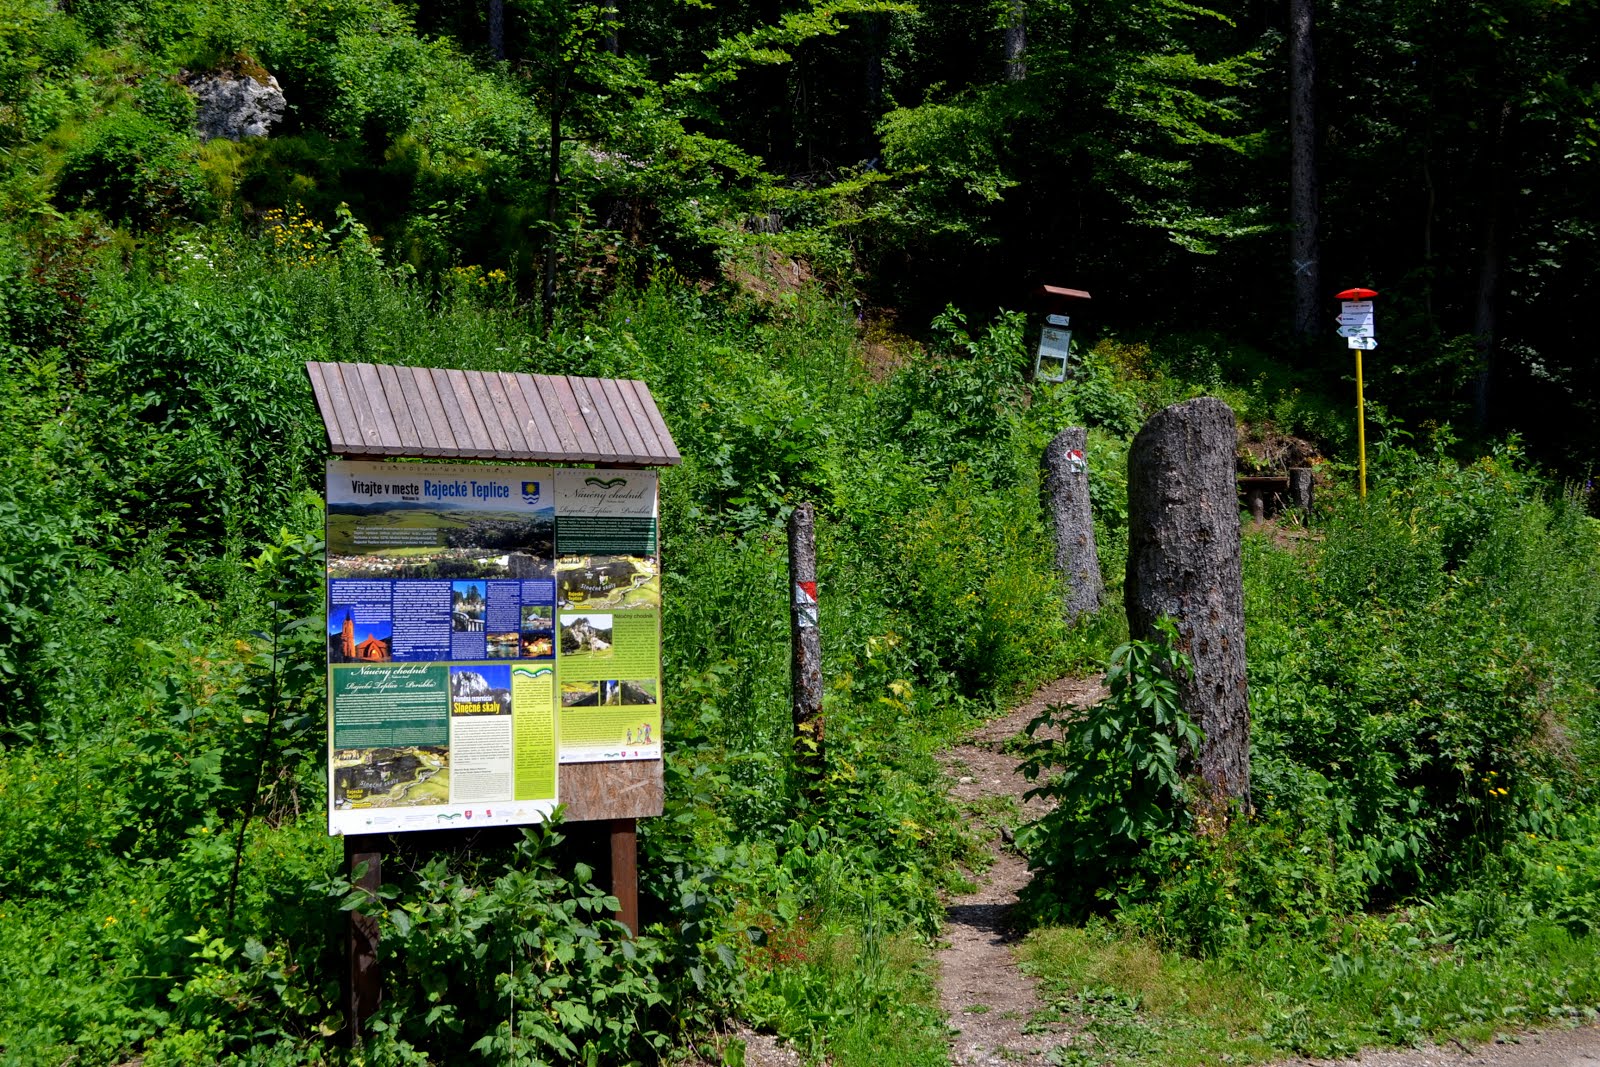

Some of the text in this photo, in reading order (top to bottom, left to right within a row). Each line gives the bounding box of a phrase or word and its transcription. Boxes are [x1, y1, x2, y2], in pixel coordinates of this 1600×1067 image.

[351, 480, 509, 501] Vitajte v meste Rajecké Teplice
[351, 662, 431, 682] Náučný chodník
[453, 701, 500, 714] Slnečné skaly
